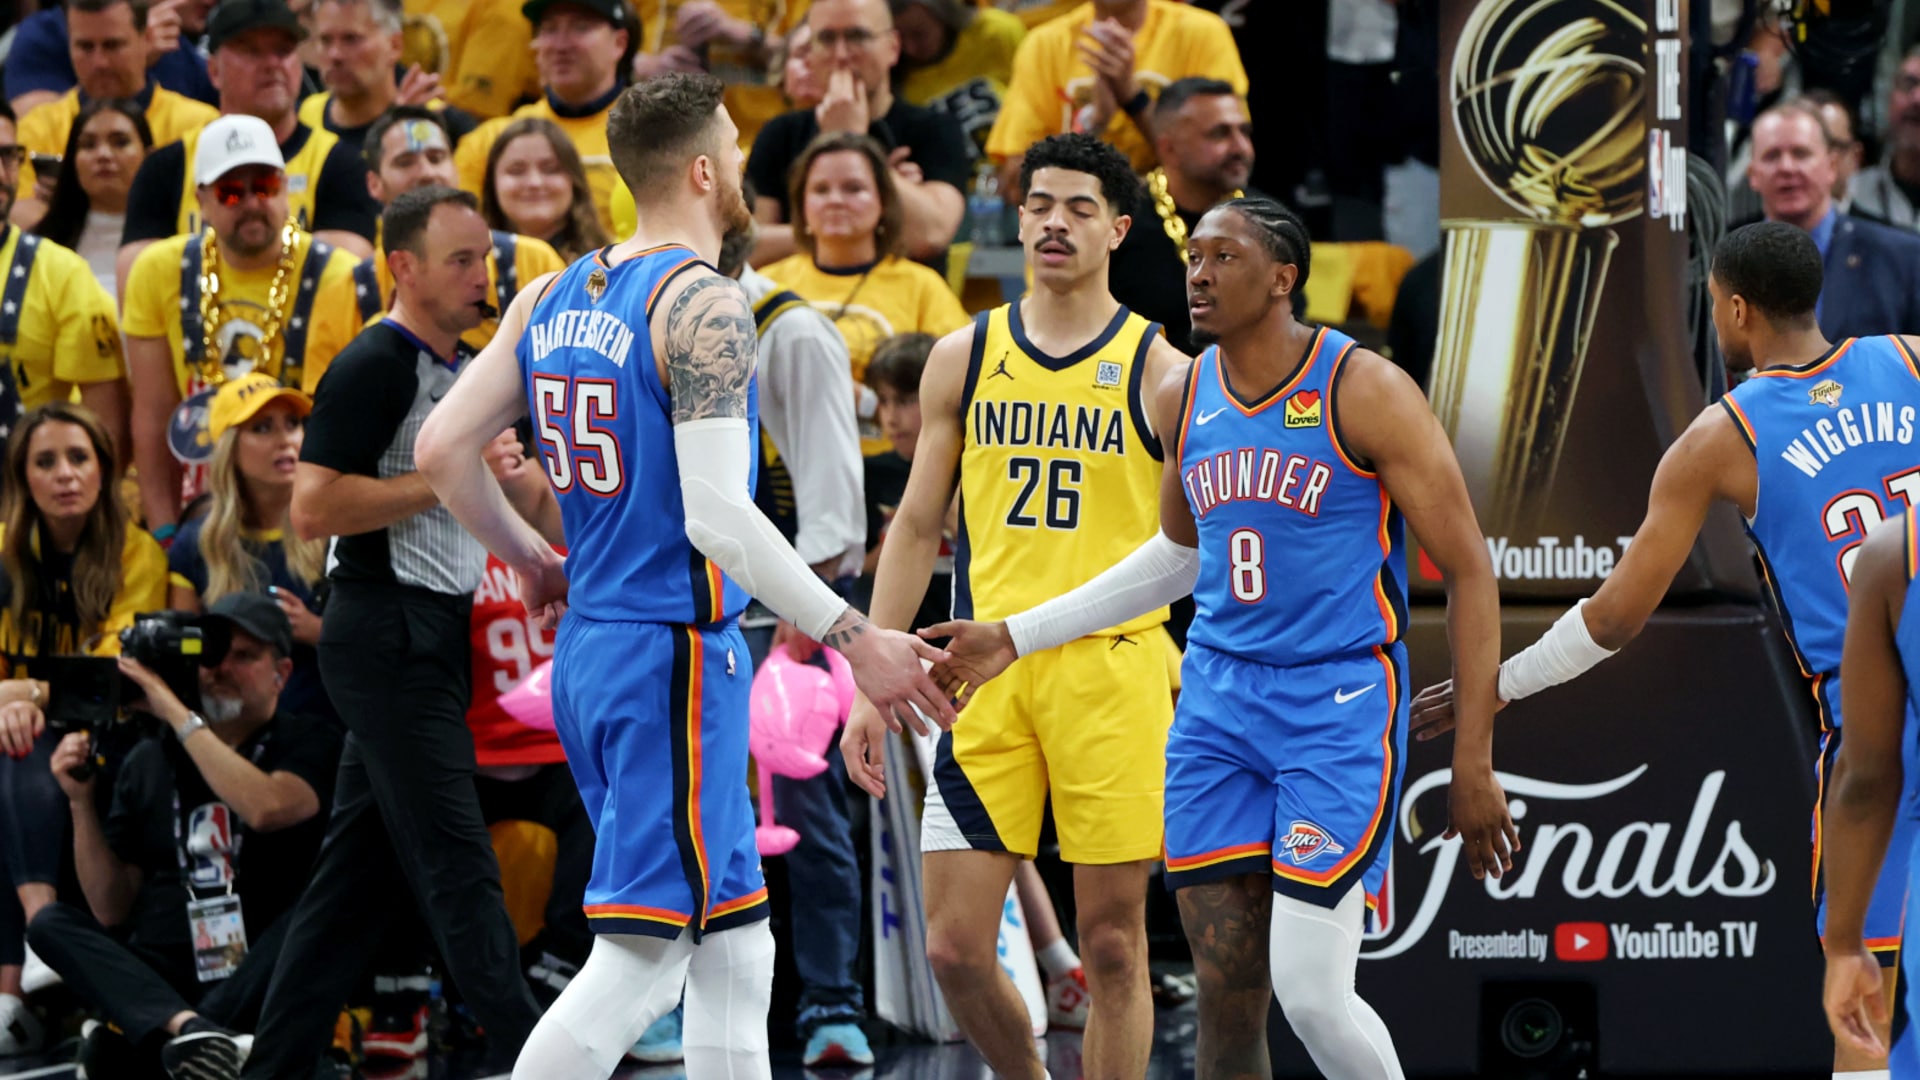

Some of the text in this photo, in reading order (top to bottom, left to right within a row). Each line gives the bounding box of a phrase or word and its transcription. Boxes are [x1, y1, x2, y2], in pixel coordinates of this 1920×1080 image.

[532, 372, 626, 497] 55
[974, 401, 1126, 455] INDIANA
[1781, 401, 1916, 479] WIGGINS
[1006, 457, 1083, 530] 26
[1185, 448, 1333, 521] THUNDER
[1228, 526, 1267, 604] 8
[1487, 535, 1614, 580] YouTube
[1449, 921, 1758, 962] Presented by YouTube TV
